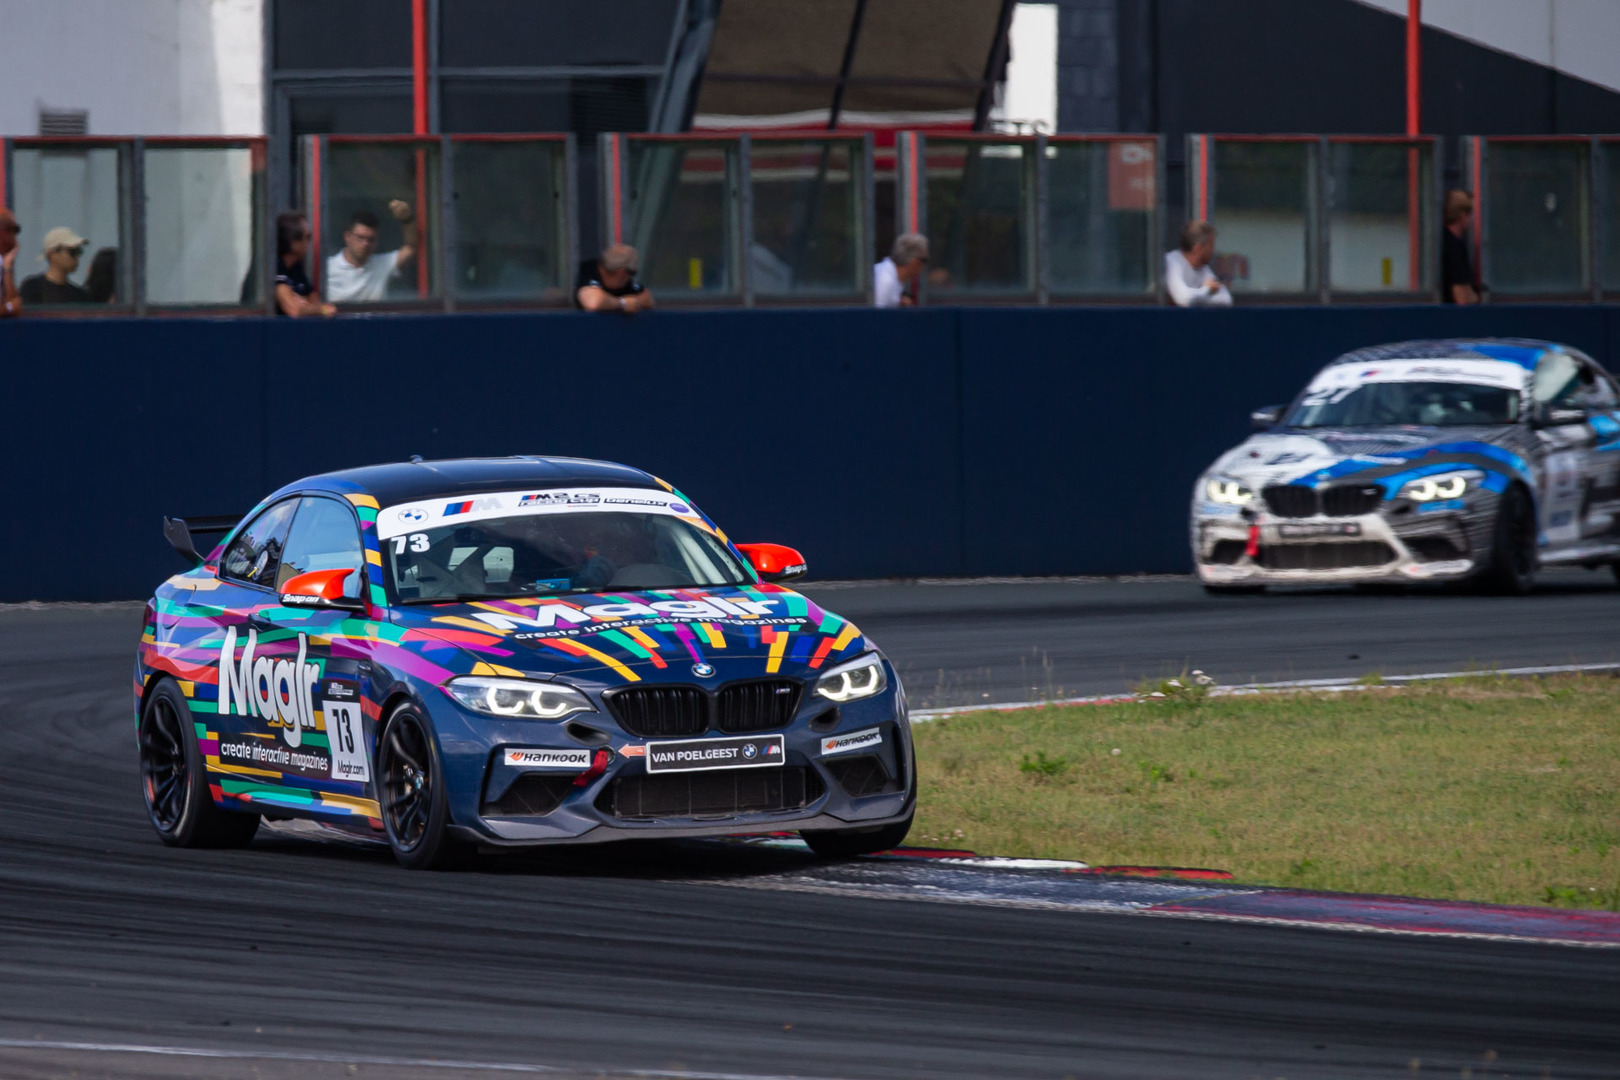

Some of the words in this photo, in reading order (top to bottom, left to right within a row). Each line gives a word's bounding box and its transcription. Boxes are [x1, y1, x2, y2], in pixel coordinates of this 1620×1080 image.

[390, 533, 430, 555] 73
[283, 593, 320, 604] Snap-on
[472, 595, 779, 630] Maglr
[514, 629, 580, 640] create
[584, 616, 692, 633] interactive
[697, 616, 808, 626] magazines
[218, 625, 320, 748] Maglr
[221, 741, 251, 759] create
[251, 741, 289, 764] interactive
[291, 750, 328, 772] magazines
[652, 751, 675, 763] VAN
[677, 748, 739, 761] POELGEEST
[337, 759, 365, 777] Maglr.com
